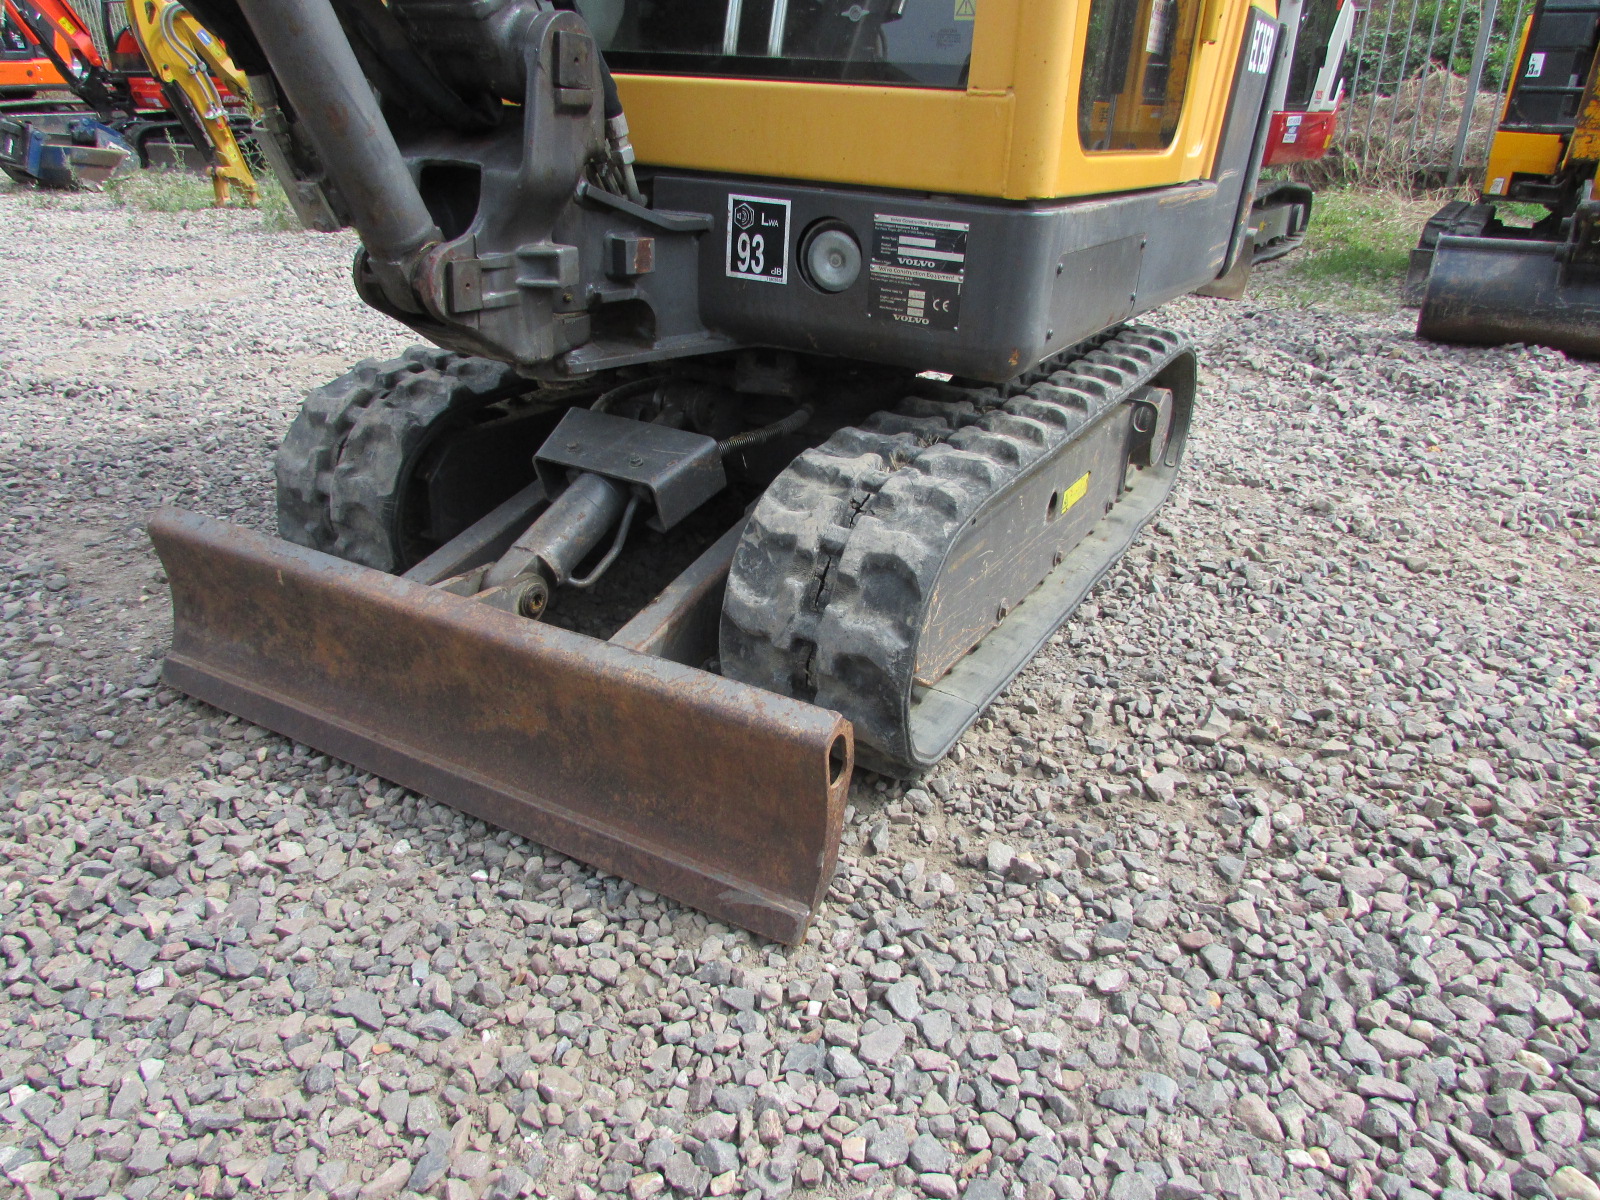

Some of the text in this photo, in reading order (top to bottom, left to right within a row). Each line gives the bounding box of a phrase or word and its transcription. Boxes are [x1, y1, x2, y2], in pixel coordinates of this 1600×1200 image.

[928, 220, 951, 228] Equipment
[738, 232, 763, 274] 93
[897, 257, 936, 267] VOLVO
[771, 267, 782, 276] dB
[893, 268, 926, 277] Construction
[926, 272, 955, 281] Equipment
[893, 314, 930, 325] VOLVO
